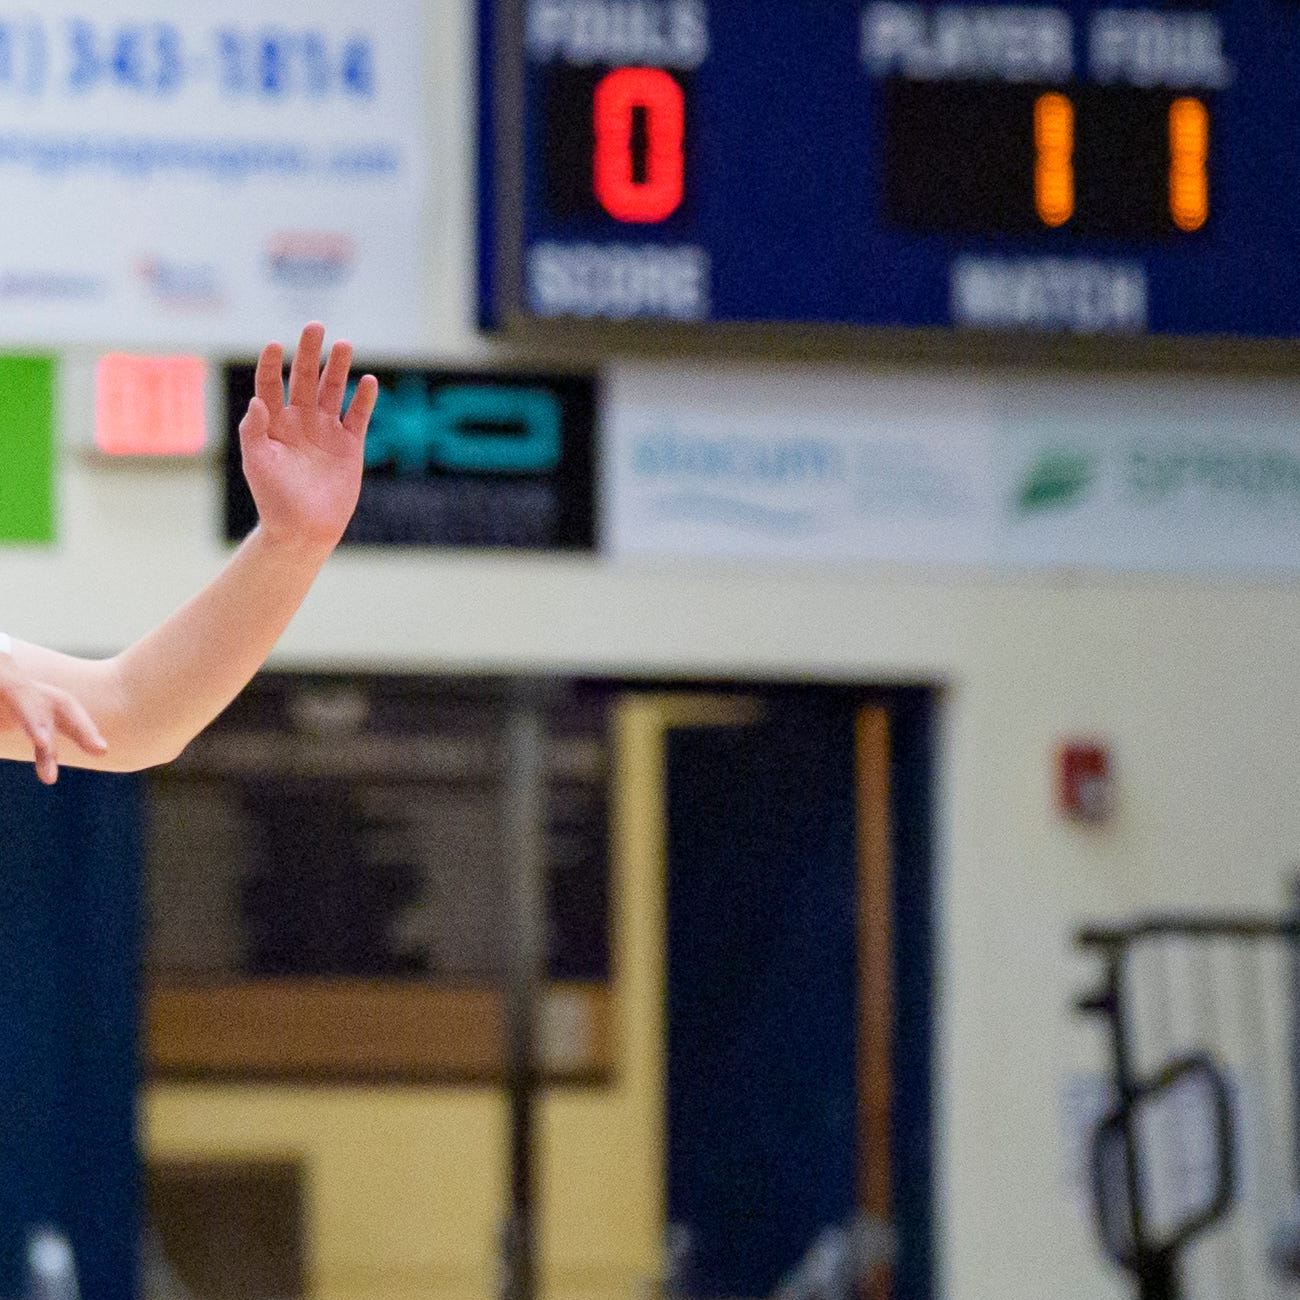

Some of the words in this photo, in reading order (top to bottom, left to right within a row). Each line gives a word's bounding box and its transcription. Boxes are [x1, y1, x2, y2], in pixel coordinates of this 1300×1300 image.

[862, 4, 1074, 80] PLAYER
[1090, 8, 1234, 88] FOUL
[593, 65, 685, 223] 0
[526, 244, 708, 318] SCORE
